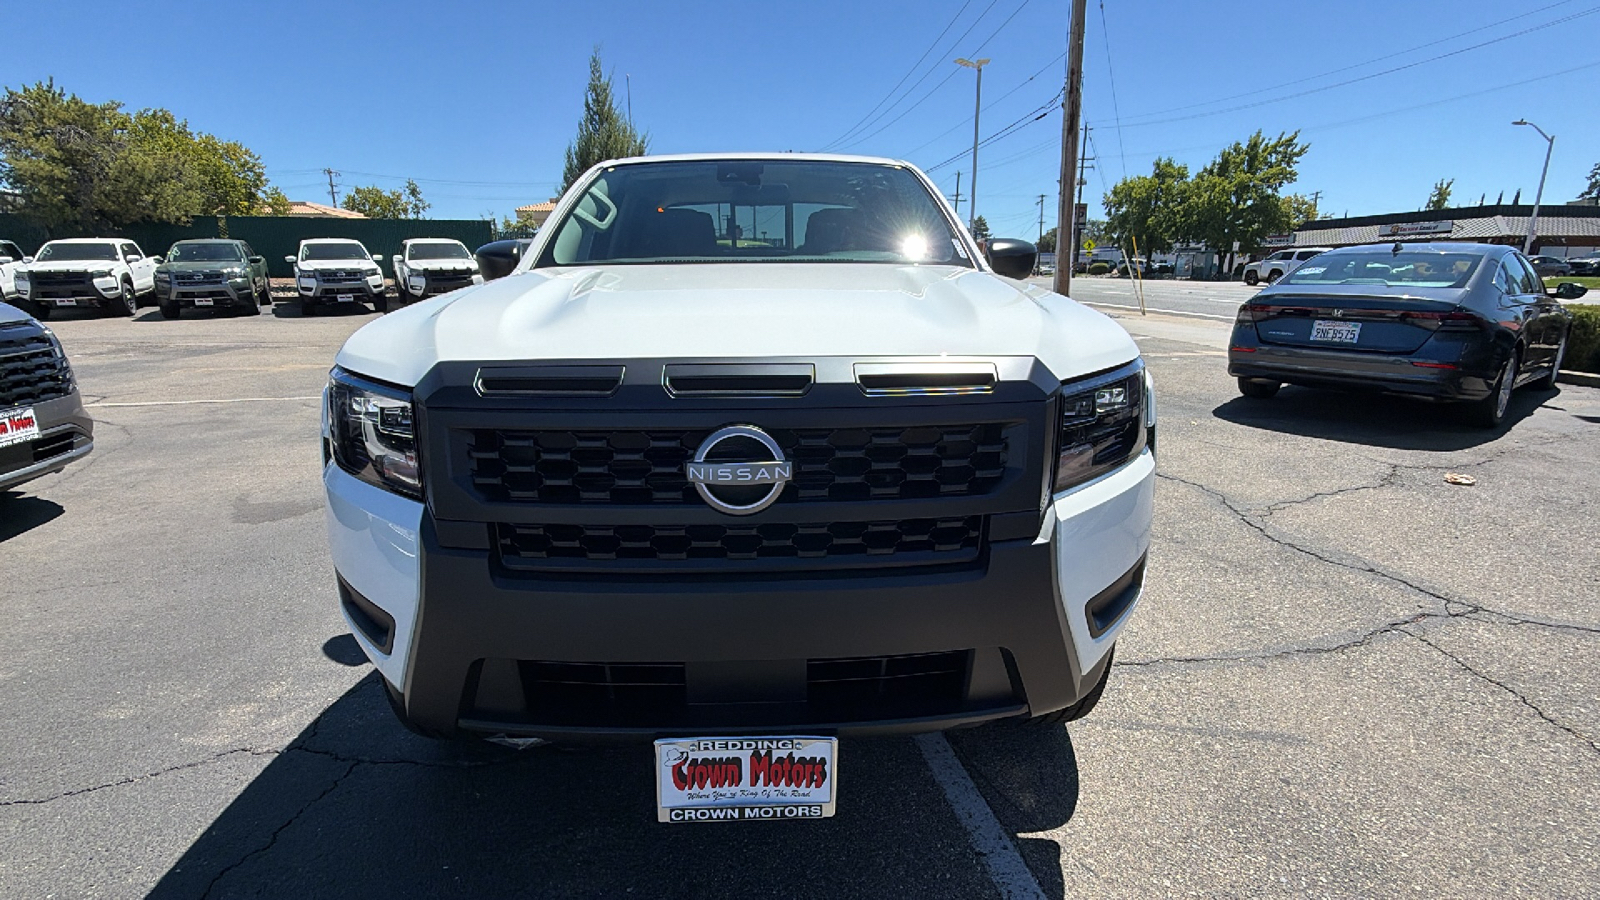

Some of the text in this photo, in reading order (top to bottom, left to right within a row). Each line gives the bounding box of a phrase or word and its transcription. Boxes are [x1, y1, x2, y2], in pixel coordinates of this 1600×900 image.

[689, 466, 789, 480] NISSAN
[701, 741, 793, 751] REDDING
[671, 750, 827, 791] Crown Motors
[687, 789, 811, 801] Where You're King Of The Road
[671, 806, 821, 821] CROWN MOTORS
